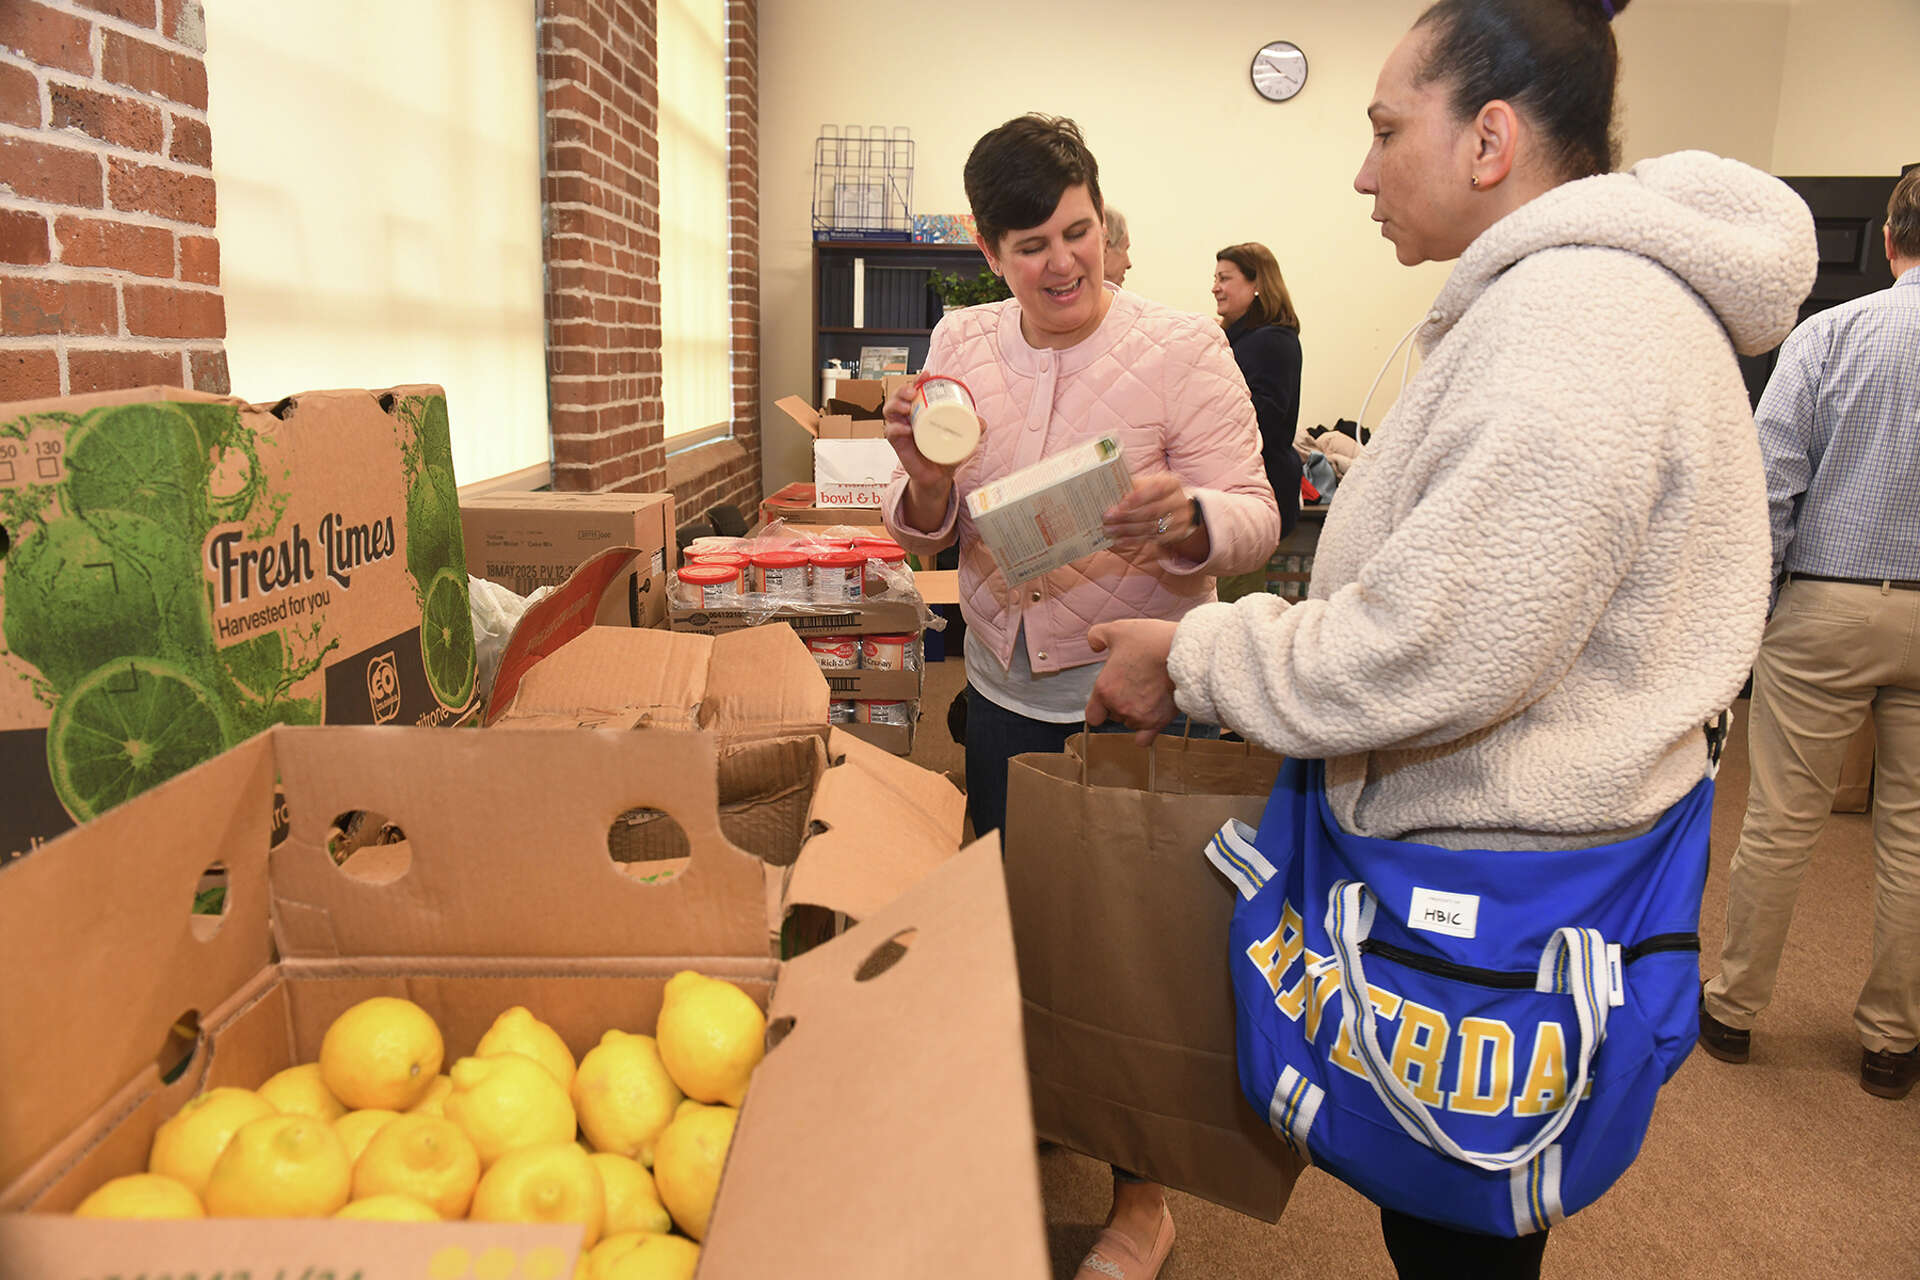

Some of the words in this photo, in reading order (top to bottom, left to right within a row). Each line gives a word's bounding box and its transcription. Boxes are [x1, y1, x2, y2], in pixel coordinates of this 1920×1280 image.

[35, 440, 61, 455] 130
[821, 492, 853, 504] bowl
[857, 493, 868, 504] &
[209, 523, 314, 606] Fresh
[318, 512, 396, 590] Limes
[217, 597, 287, 639] Harvested
[288, 596, 306, 617] for
[308, 590, 331, 615] you
[1424, 908, 1462, 925] HBIC
